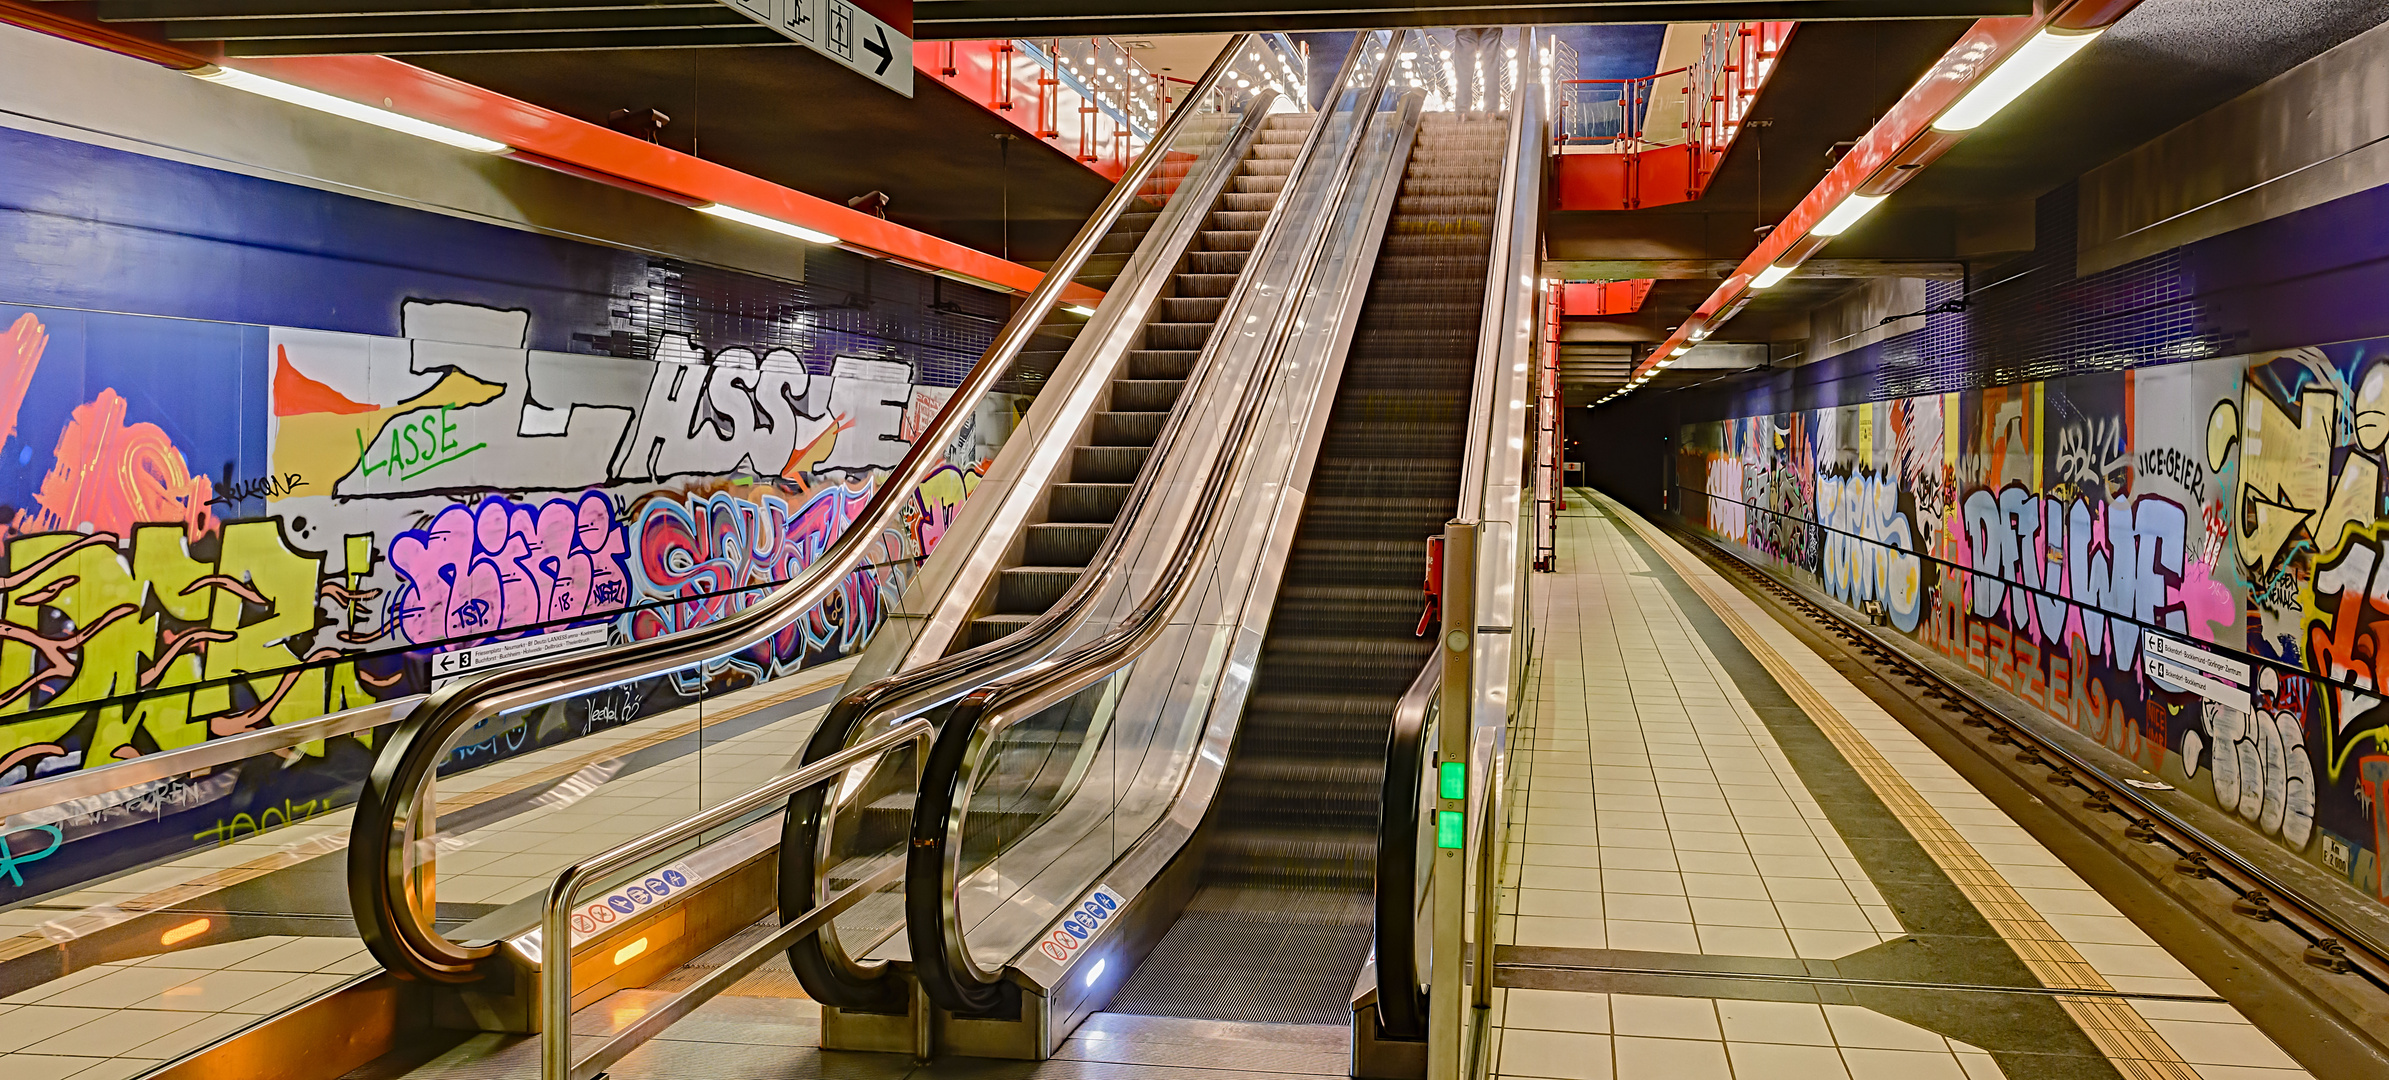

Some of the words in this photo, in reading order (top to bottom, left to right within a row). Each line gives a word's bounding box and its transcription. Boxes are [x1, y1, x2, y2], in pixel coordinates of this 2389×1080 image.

[356, 402, 459, 477] LASSE
[504, 642, 526, 650] Neumarkt
[499, 651, 521, 660] Buchheim
